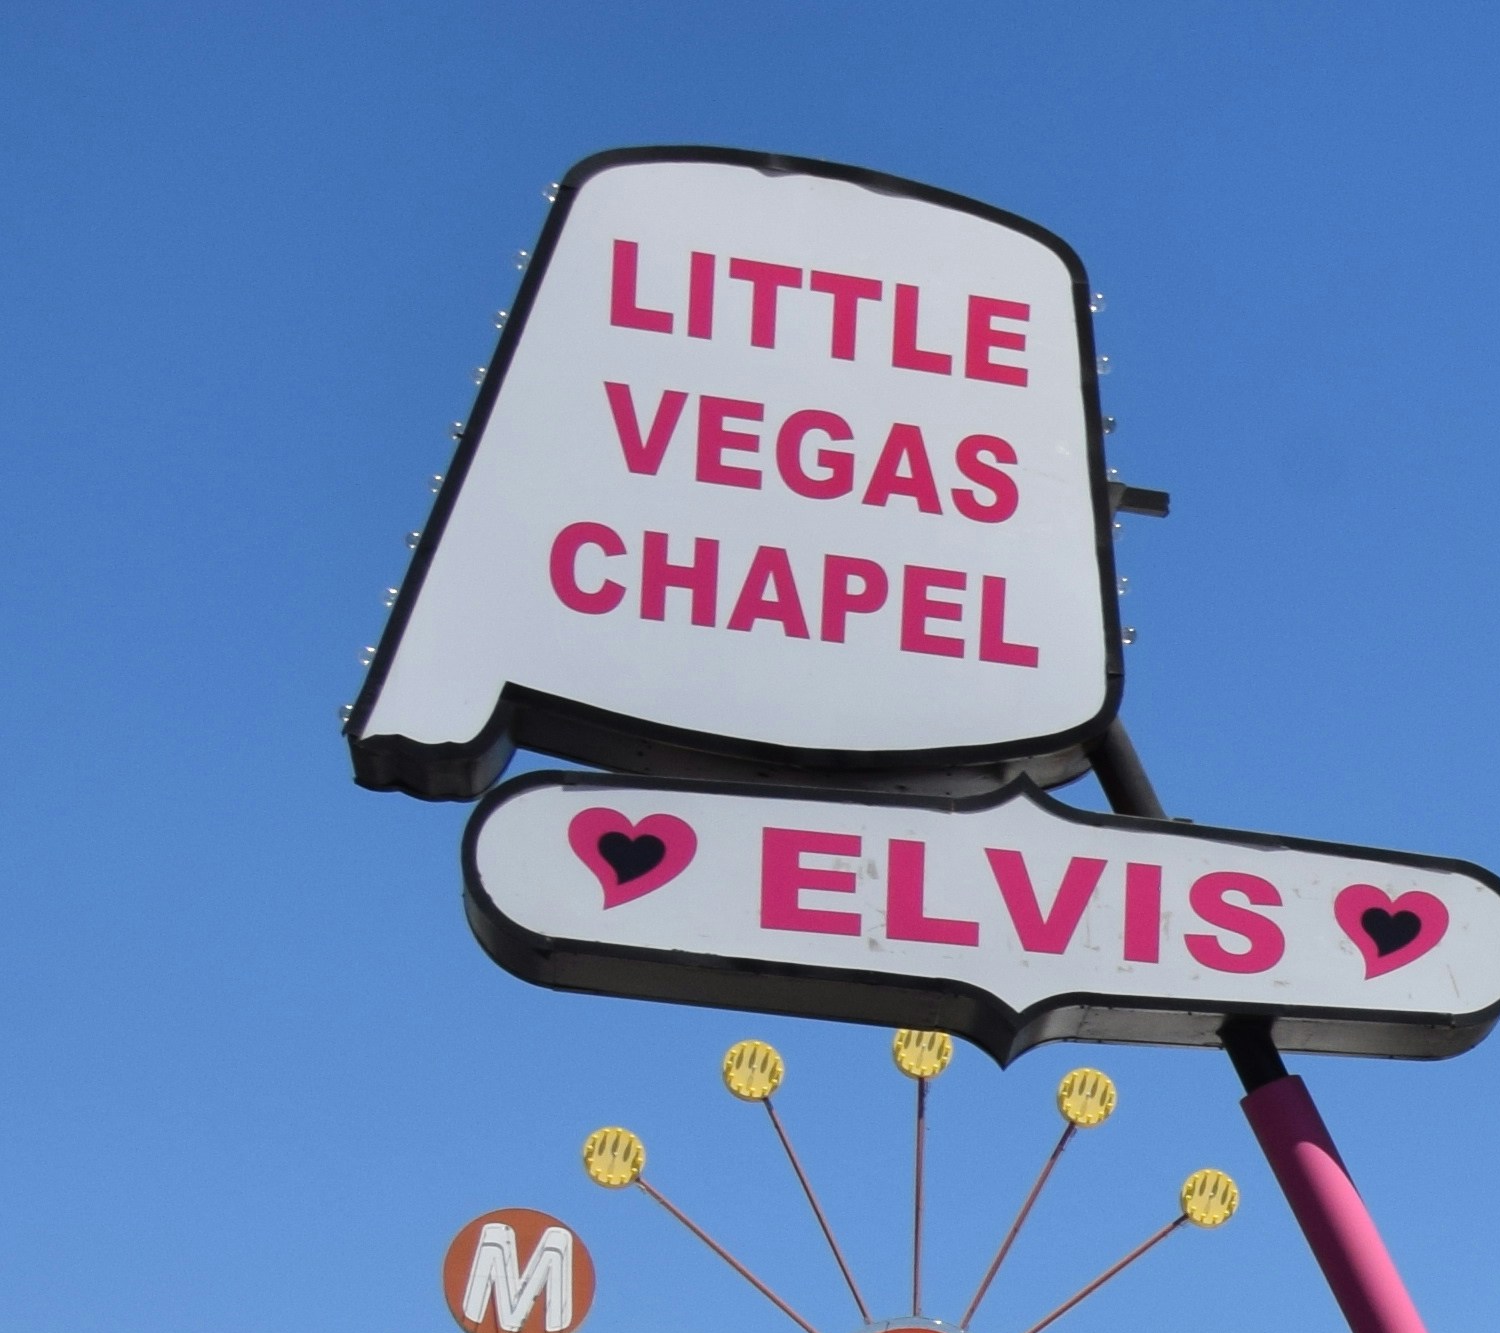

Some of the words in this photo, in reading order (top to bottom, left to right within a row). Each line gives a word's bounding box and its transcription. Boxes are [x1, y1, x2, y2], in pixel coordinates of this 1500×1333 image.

[607, 238, 1032, 388] LITTLE
[602, 380, 1022, 524] VEGAS
[548, 520, 1040, 669] CHAPEL
[759, 826, 1287, 975] ELVIS
